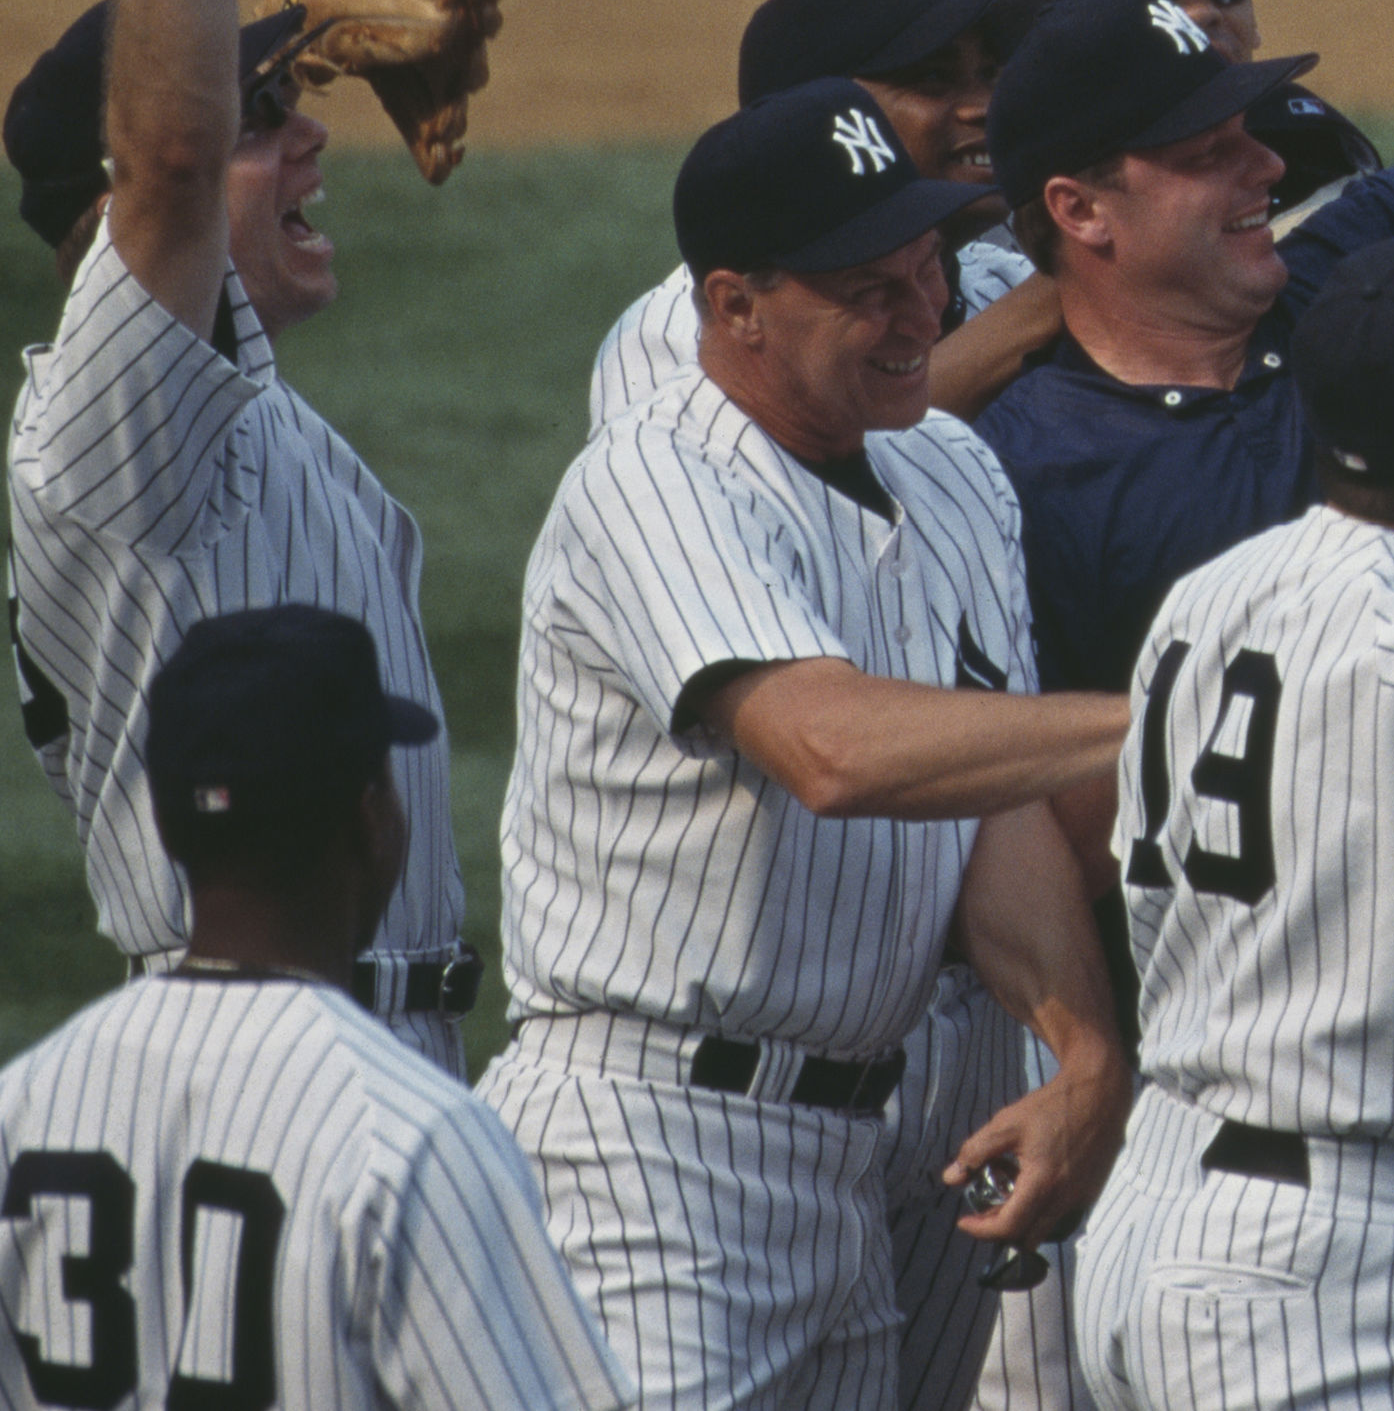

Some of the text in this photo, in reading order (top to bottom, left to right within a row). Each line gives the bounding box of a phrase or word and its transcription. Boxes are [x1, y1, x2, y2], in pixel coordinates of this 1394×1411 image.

[832, 108, 896, 176] NY
[1124, 640, 1284, 907] 19
[0, 1149, 287, 1411] 30
